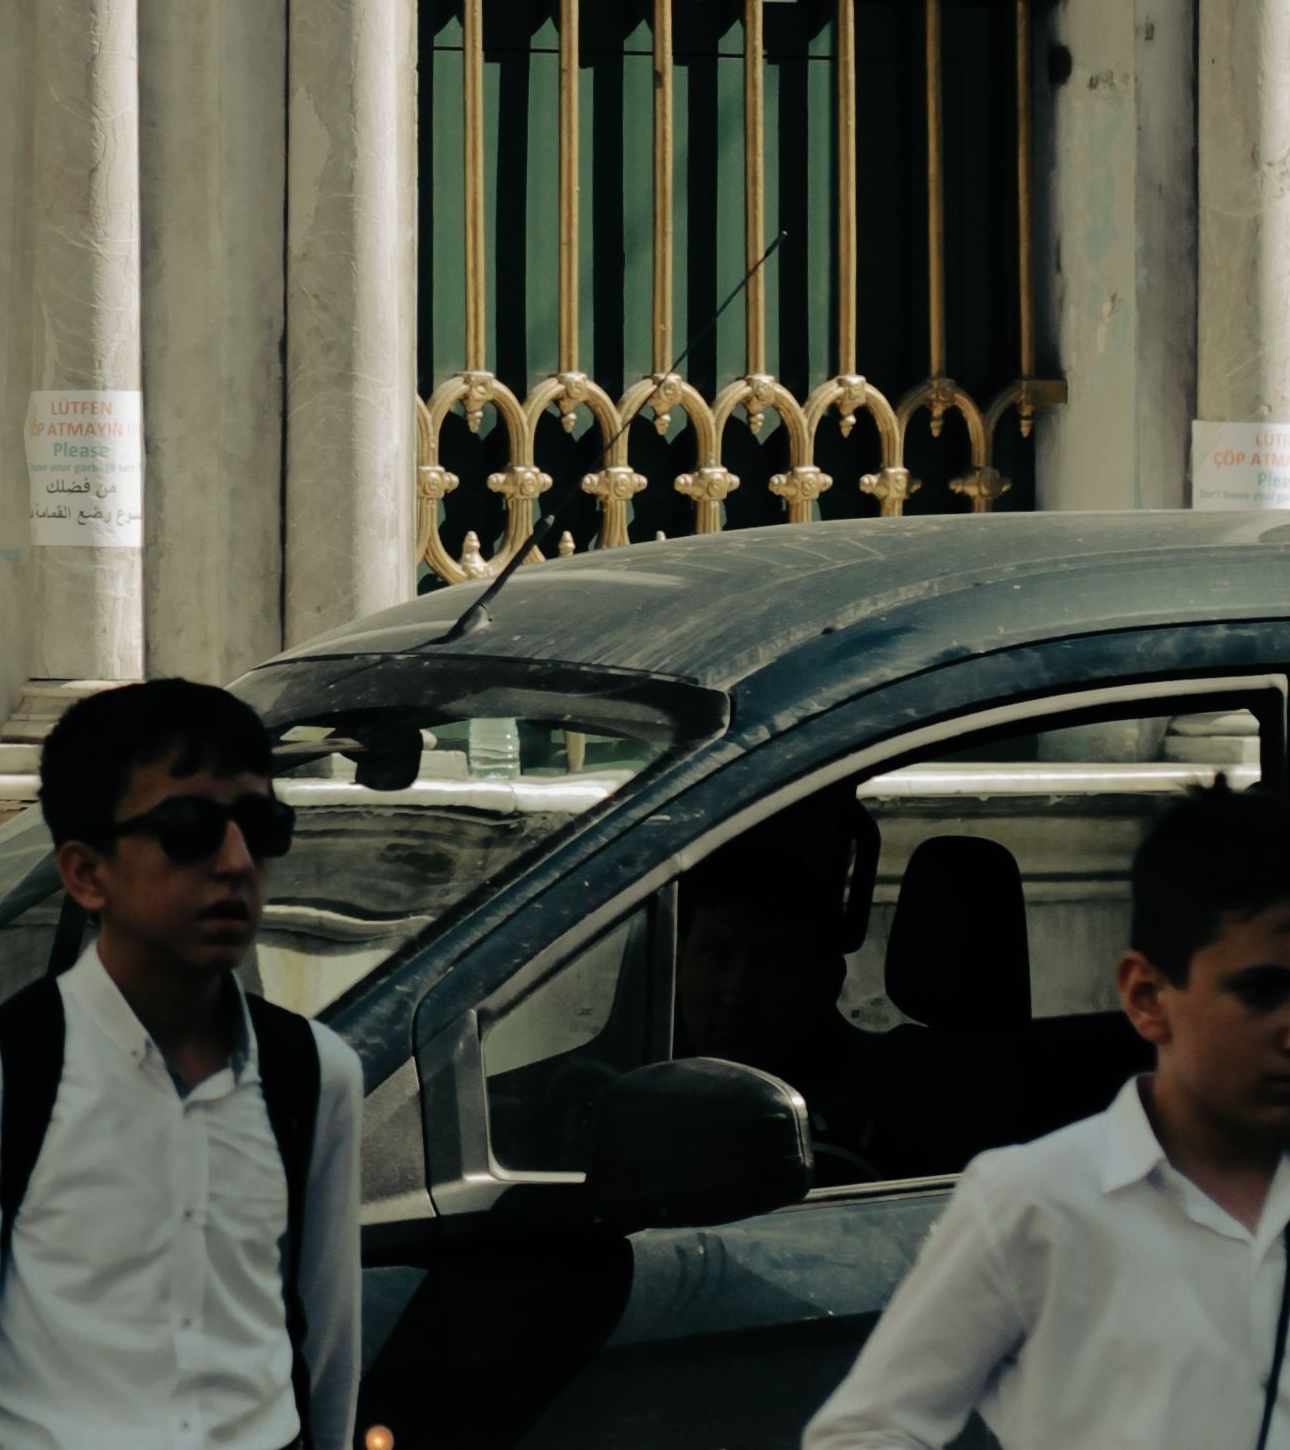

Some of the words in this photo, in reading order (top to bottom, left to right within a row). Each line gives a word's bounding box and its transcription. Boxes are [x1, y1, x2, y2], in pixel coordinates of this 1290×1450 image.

[51, 397, 113, 416] LÜTFEN
[48, 422, 123, 437] ATMAYIN
[53, 442, 109, 458] Please
[1213, 447, 1246, 469] ÇÖP
[46, 477, 91, 495] فضلك
